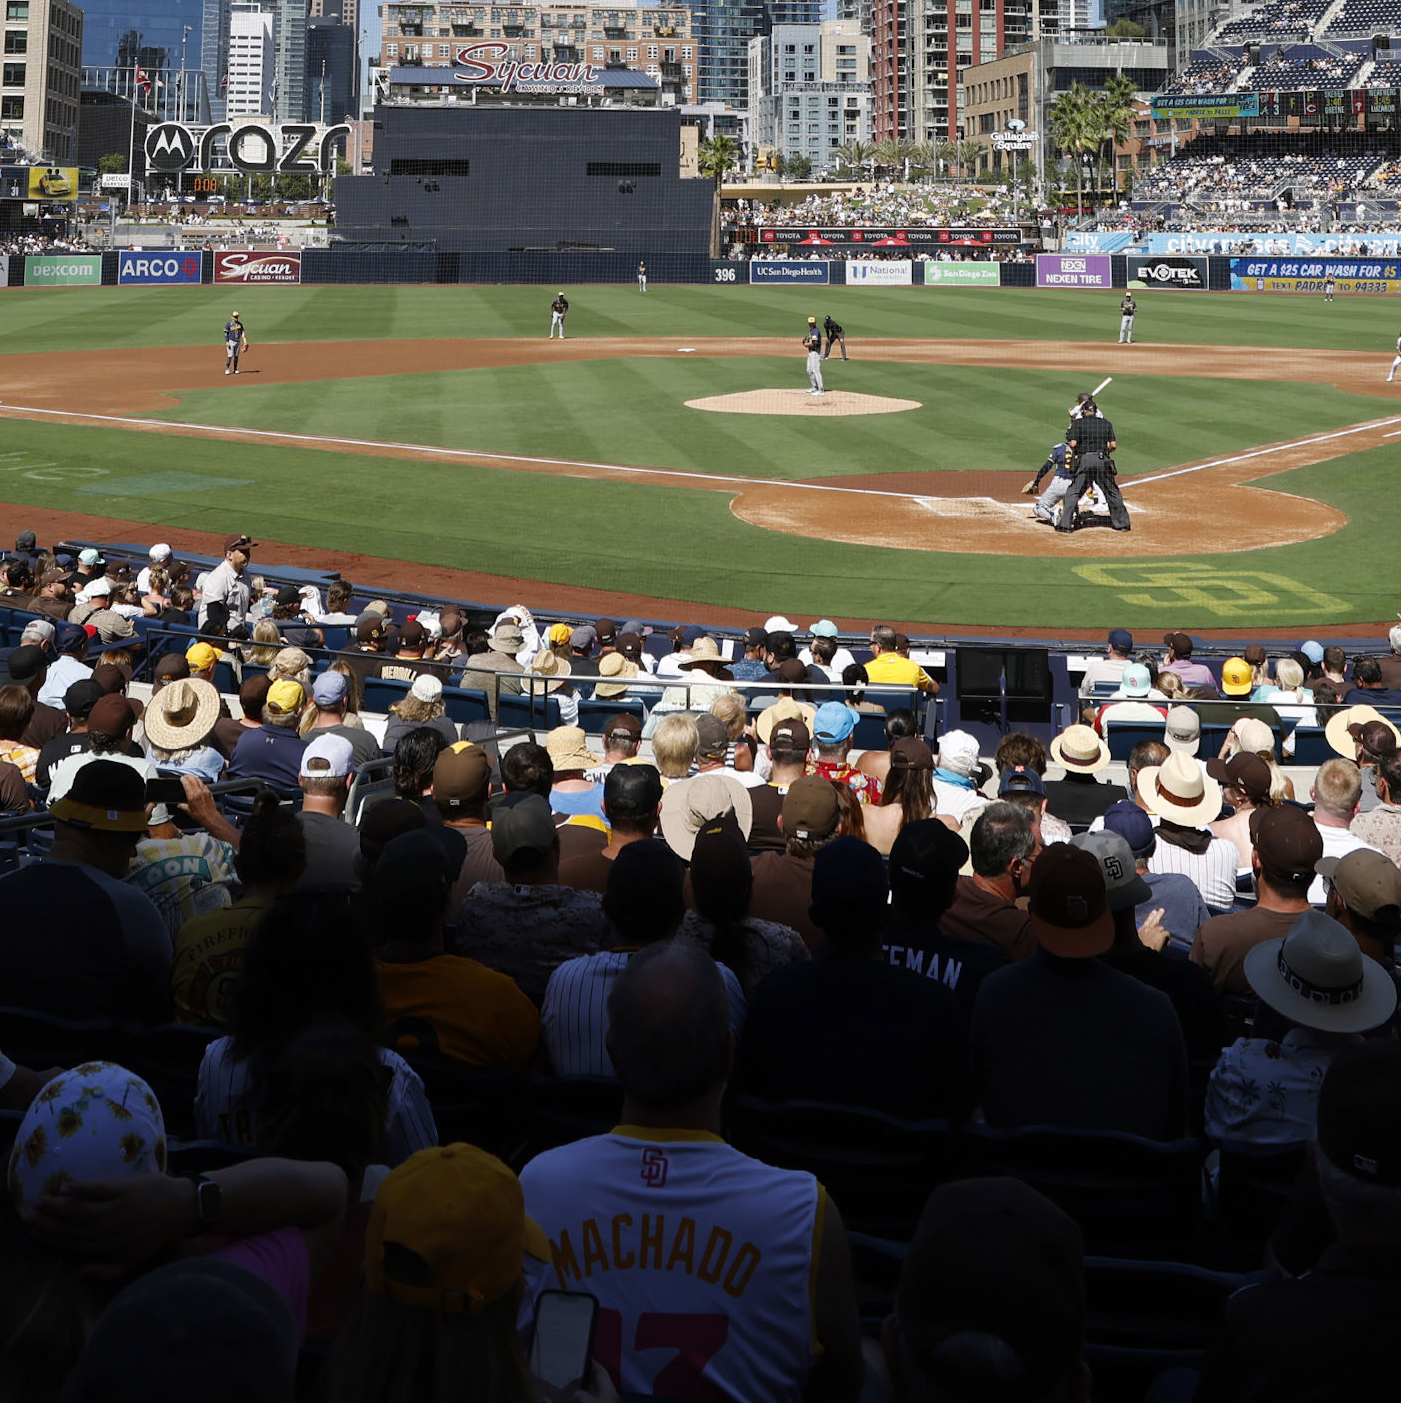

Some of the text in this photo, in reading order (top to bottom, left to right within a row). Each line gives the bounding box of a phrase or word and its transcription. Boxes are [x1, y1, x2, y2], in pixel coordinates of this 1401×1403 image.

[454, 42, 598, 93] Sycuan
[516, 84, 605, 95] CASINO RESORT
[990, 131, 1040, 143] Gallagher
[199, 123, 352, 173] razr
[998, 141, 1032, 151] Square
[1072, 234, 1098, 250] city
[122, 259, 180, 278] ARCO
[221, 254, 292, 282] Sycuan
[714, 268, 736, 282] 396
[757, 266, 823, 278] UC San Diego Health
[870, 265, 907, 274] National
[943, 269, 997, 280] San Diego Zoo
[1137, 264, 1198, 282] EVOTEK
[1247, 263, 1397, 278] GET A $25 CAR WASH FOR $5
[1045, 274, 1102, 284] NEXEN TIRE
[1338, 282, 1350, 290] TO
[1355, 281, 1388, 293] 94333
[549, 1213, 762, 1299] MACHADO
